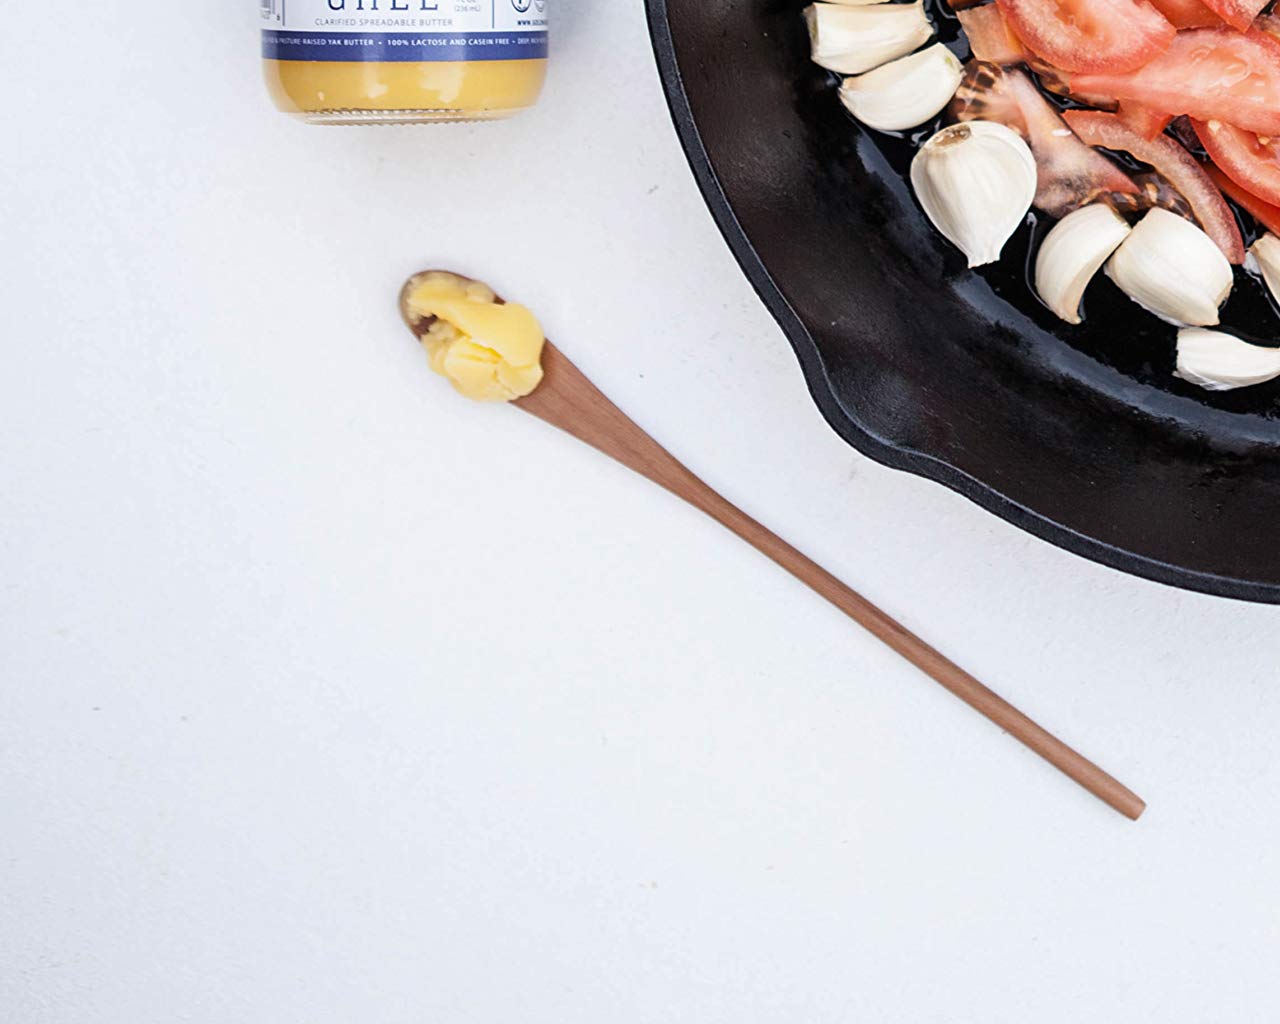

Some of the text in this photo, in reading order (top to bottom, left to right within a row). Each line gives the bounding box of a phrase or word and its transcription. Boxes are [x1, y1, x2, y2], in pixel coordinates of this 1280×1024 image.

[314, 18, 453, 26] CLARIFIED SPREADABLE BUTTER
[450, 38, 466, 46] AND
[468, 38, 494, 46] CASEIN
